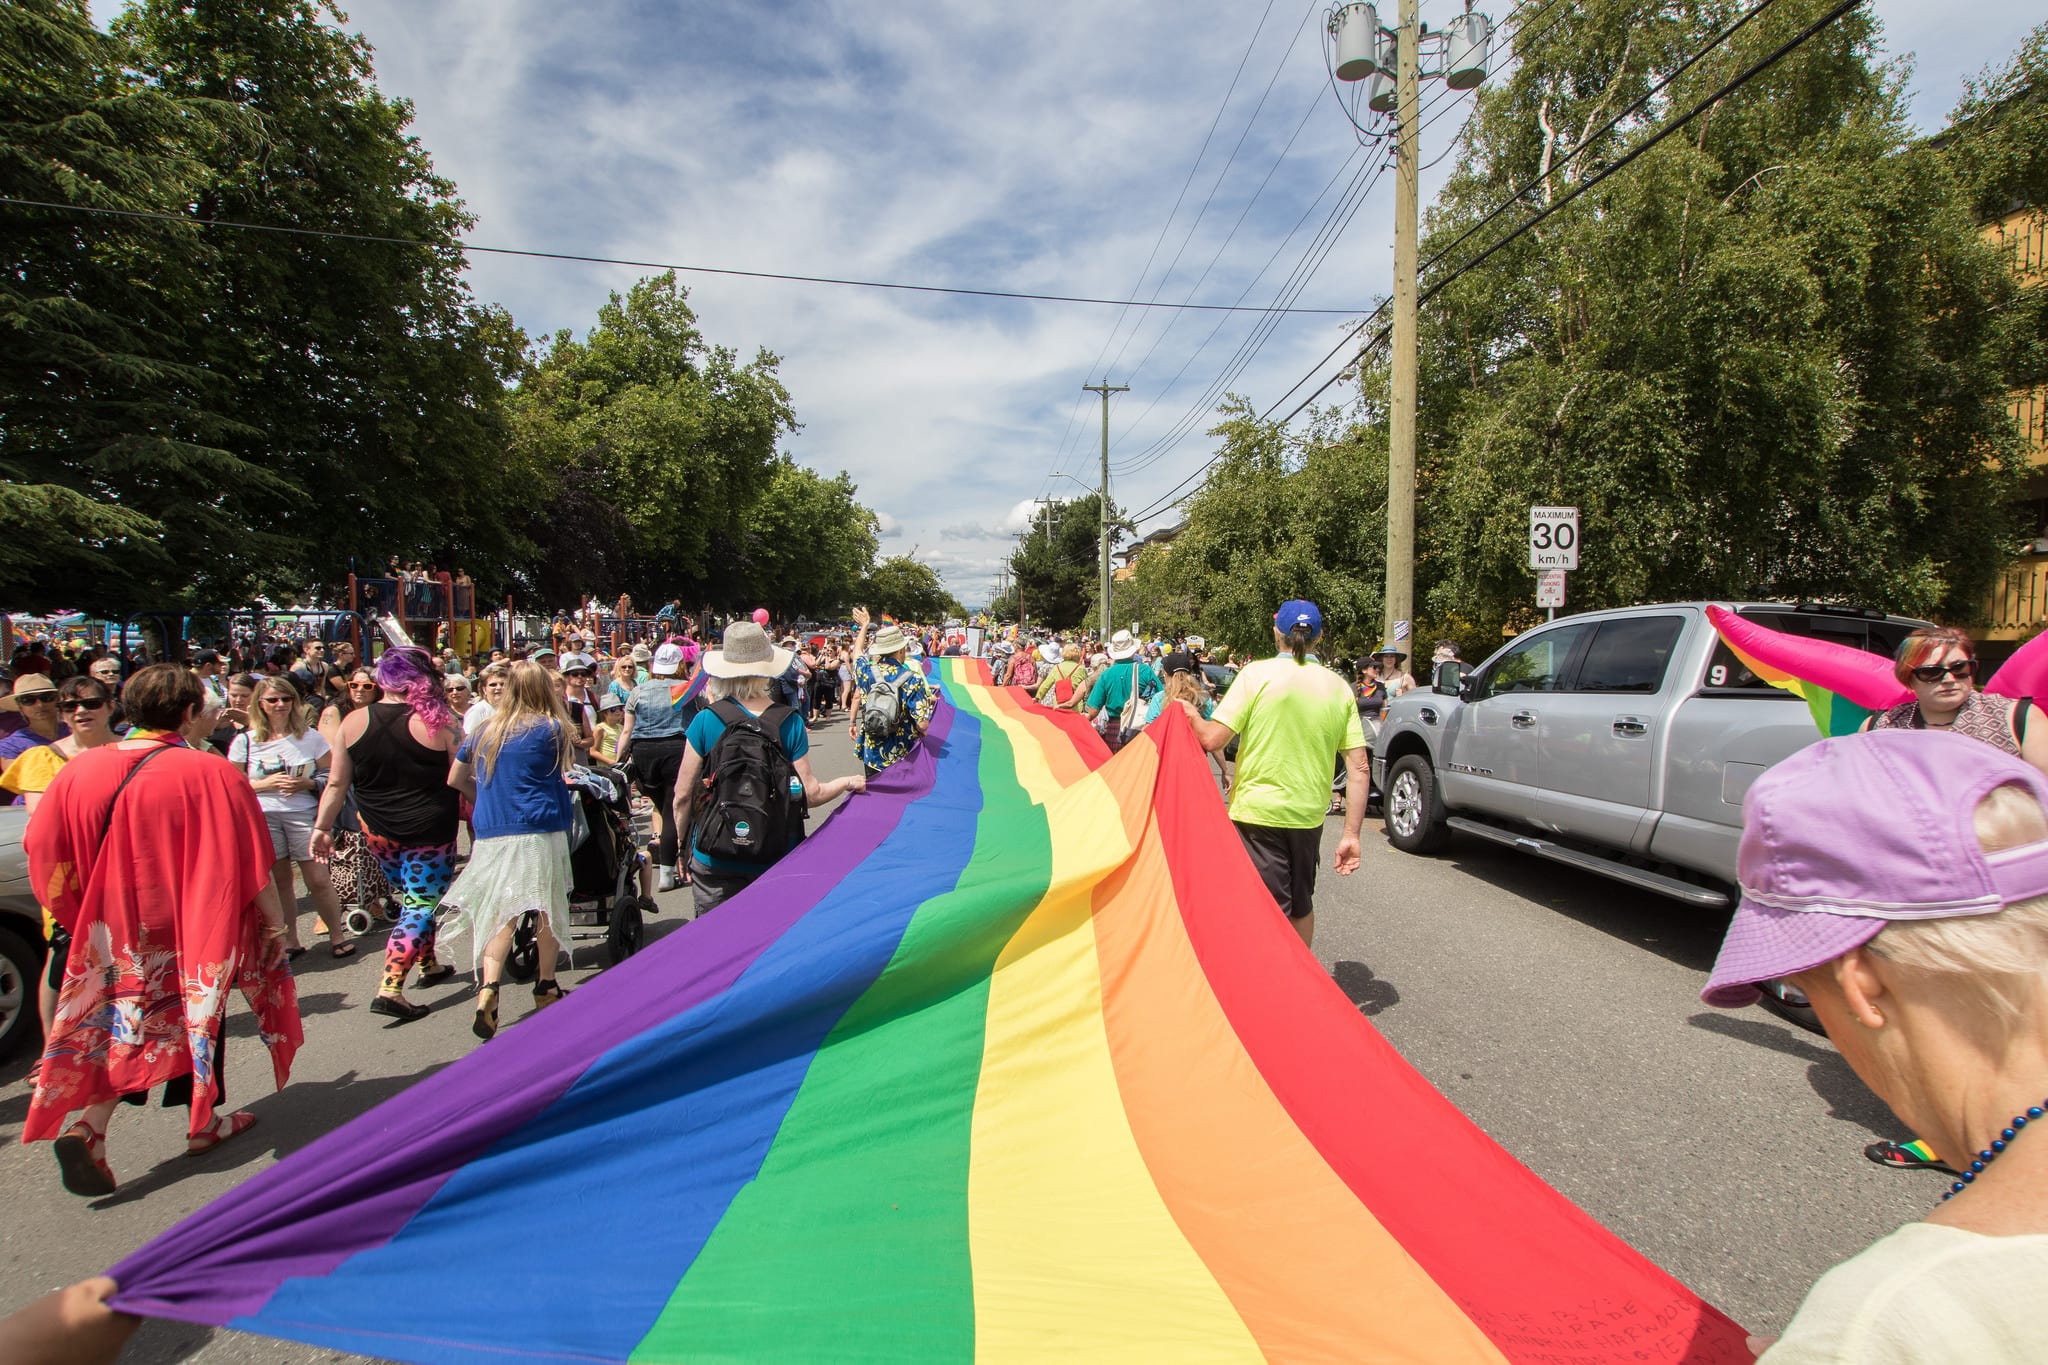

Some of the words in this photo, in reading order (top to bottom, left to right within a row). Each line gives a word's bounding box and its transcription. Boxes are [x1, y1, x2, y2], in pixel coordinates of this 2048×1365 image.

[1534, 511, 1574, 519] MAXIMUM
[1533, 523, 1575, 550] 30
[1538, 554, 1569, 565] km/h
[1711, 665, 1727, 685] 9
[1447, 762, 1477, 774] TITAN
